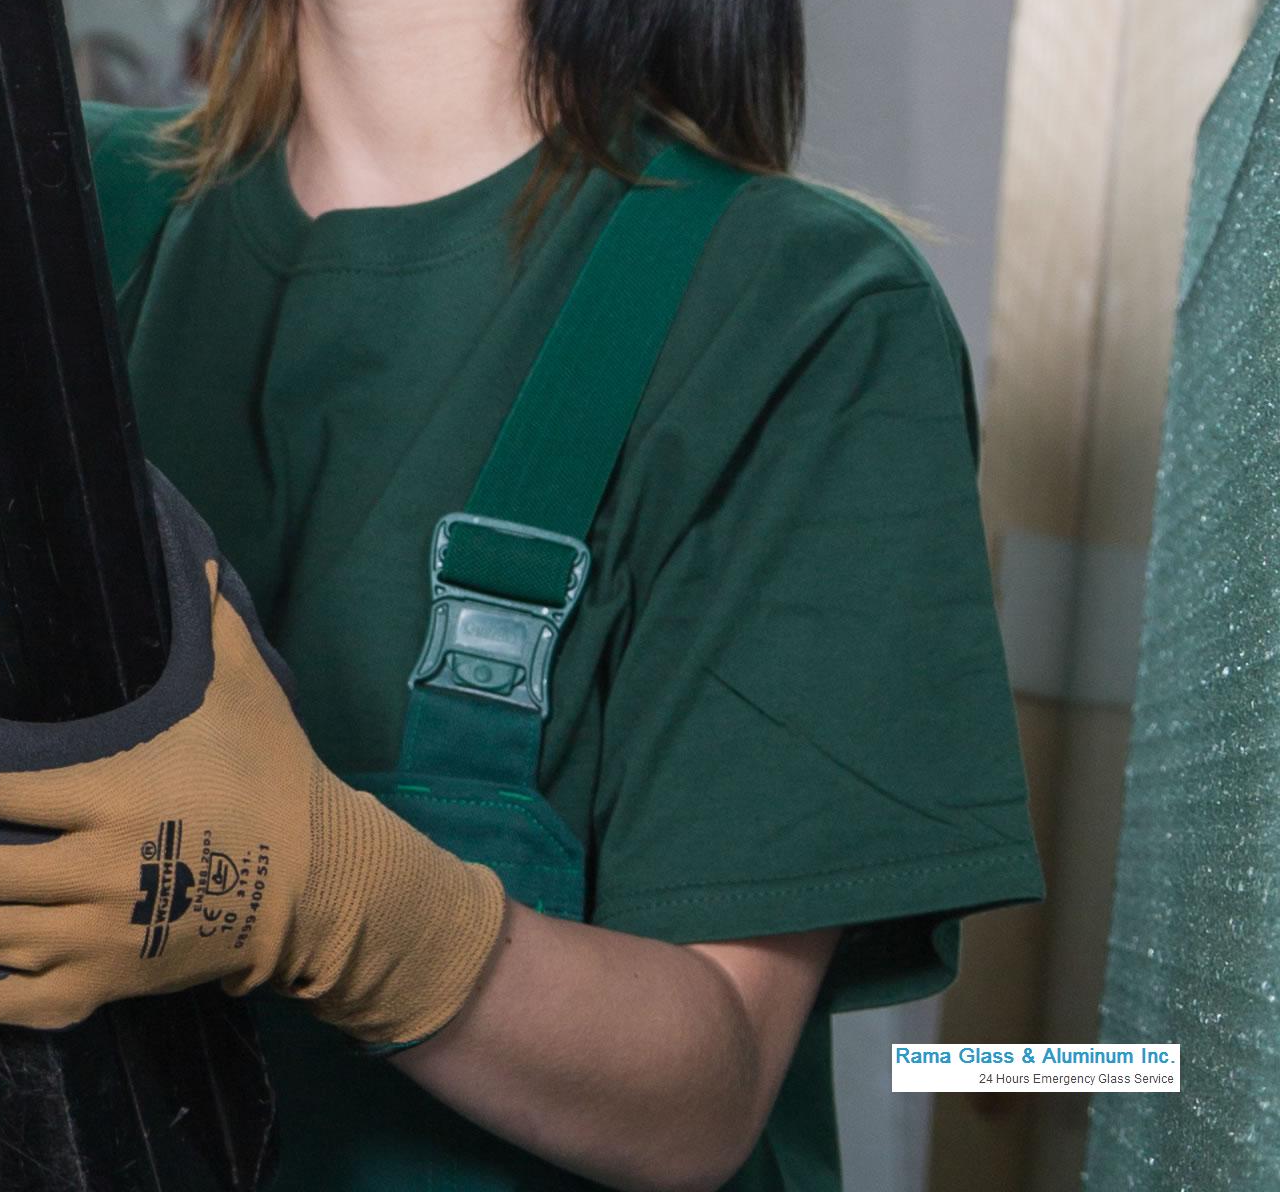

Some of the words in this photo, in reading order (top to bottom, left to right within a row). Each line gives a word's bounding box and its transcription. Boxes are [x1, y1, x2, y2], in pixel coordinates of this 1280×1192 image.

[257, 844, 270, 876] 531
[249, 880, 266, 912] 400
[221, 912, 238, 933] 10
